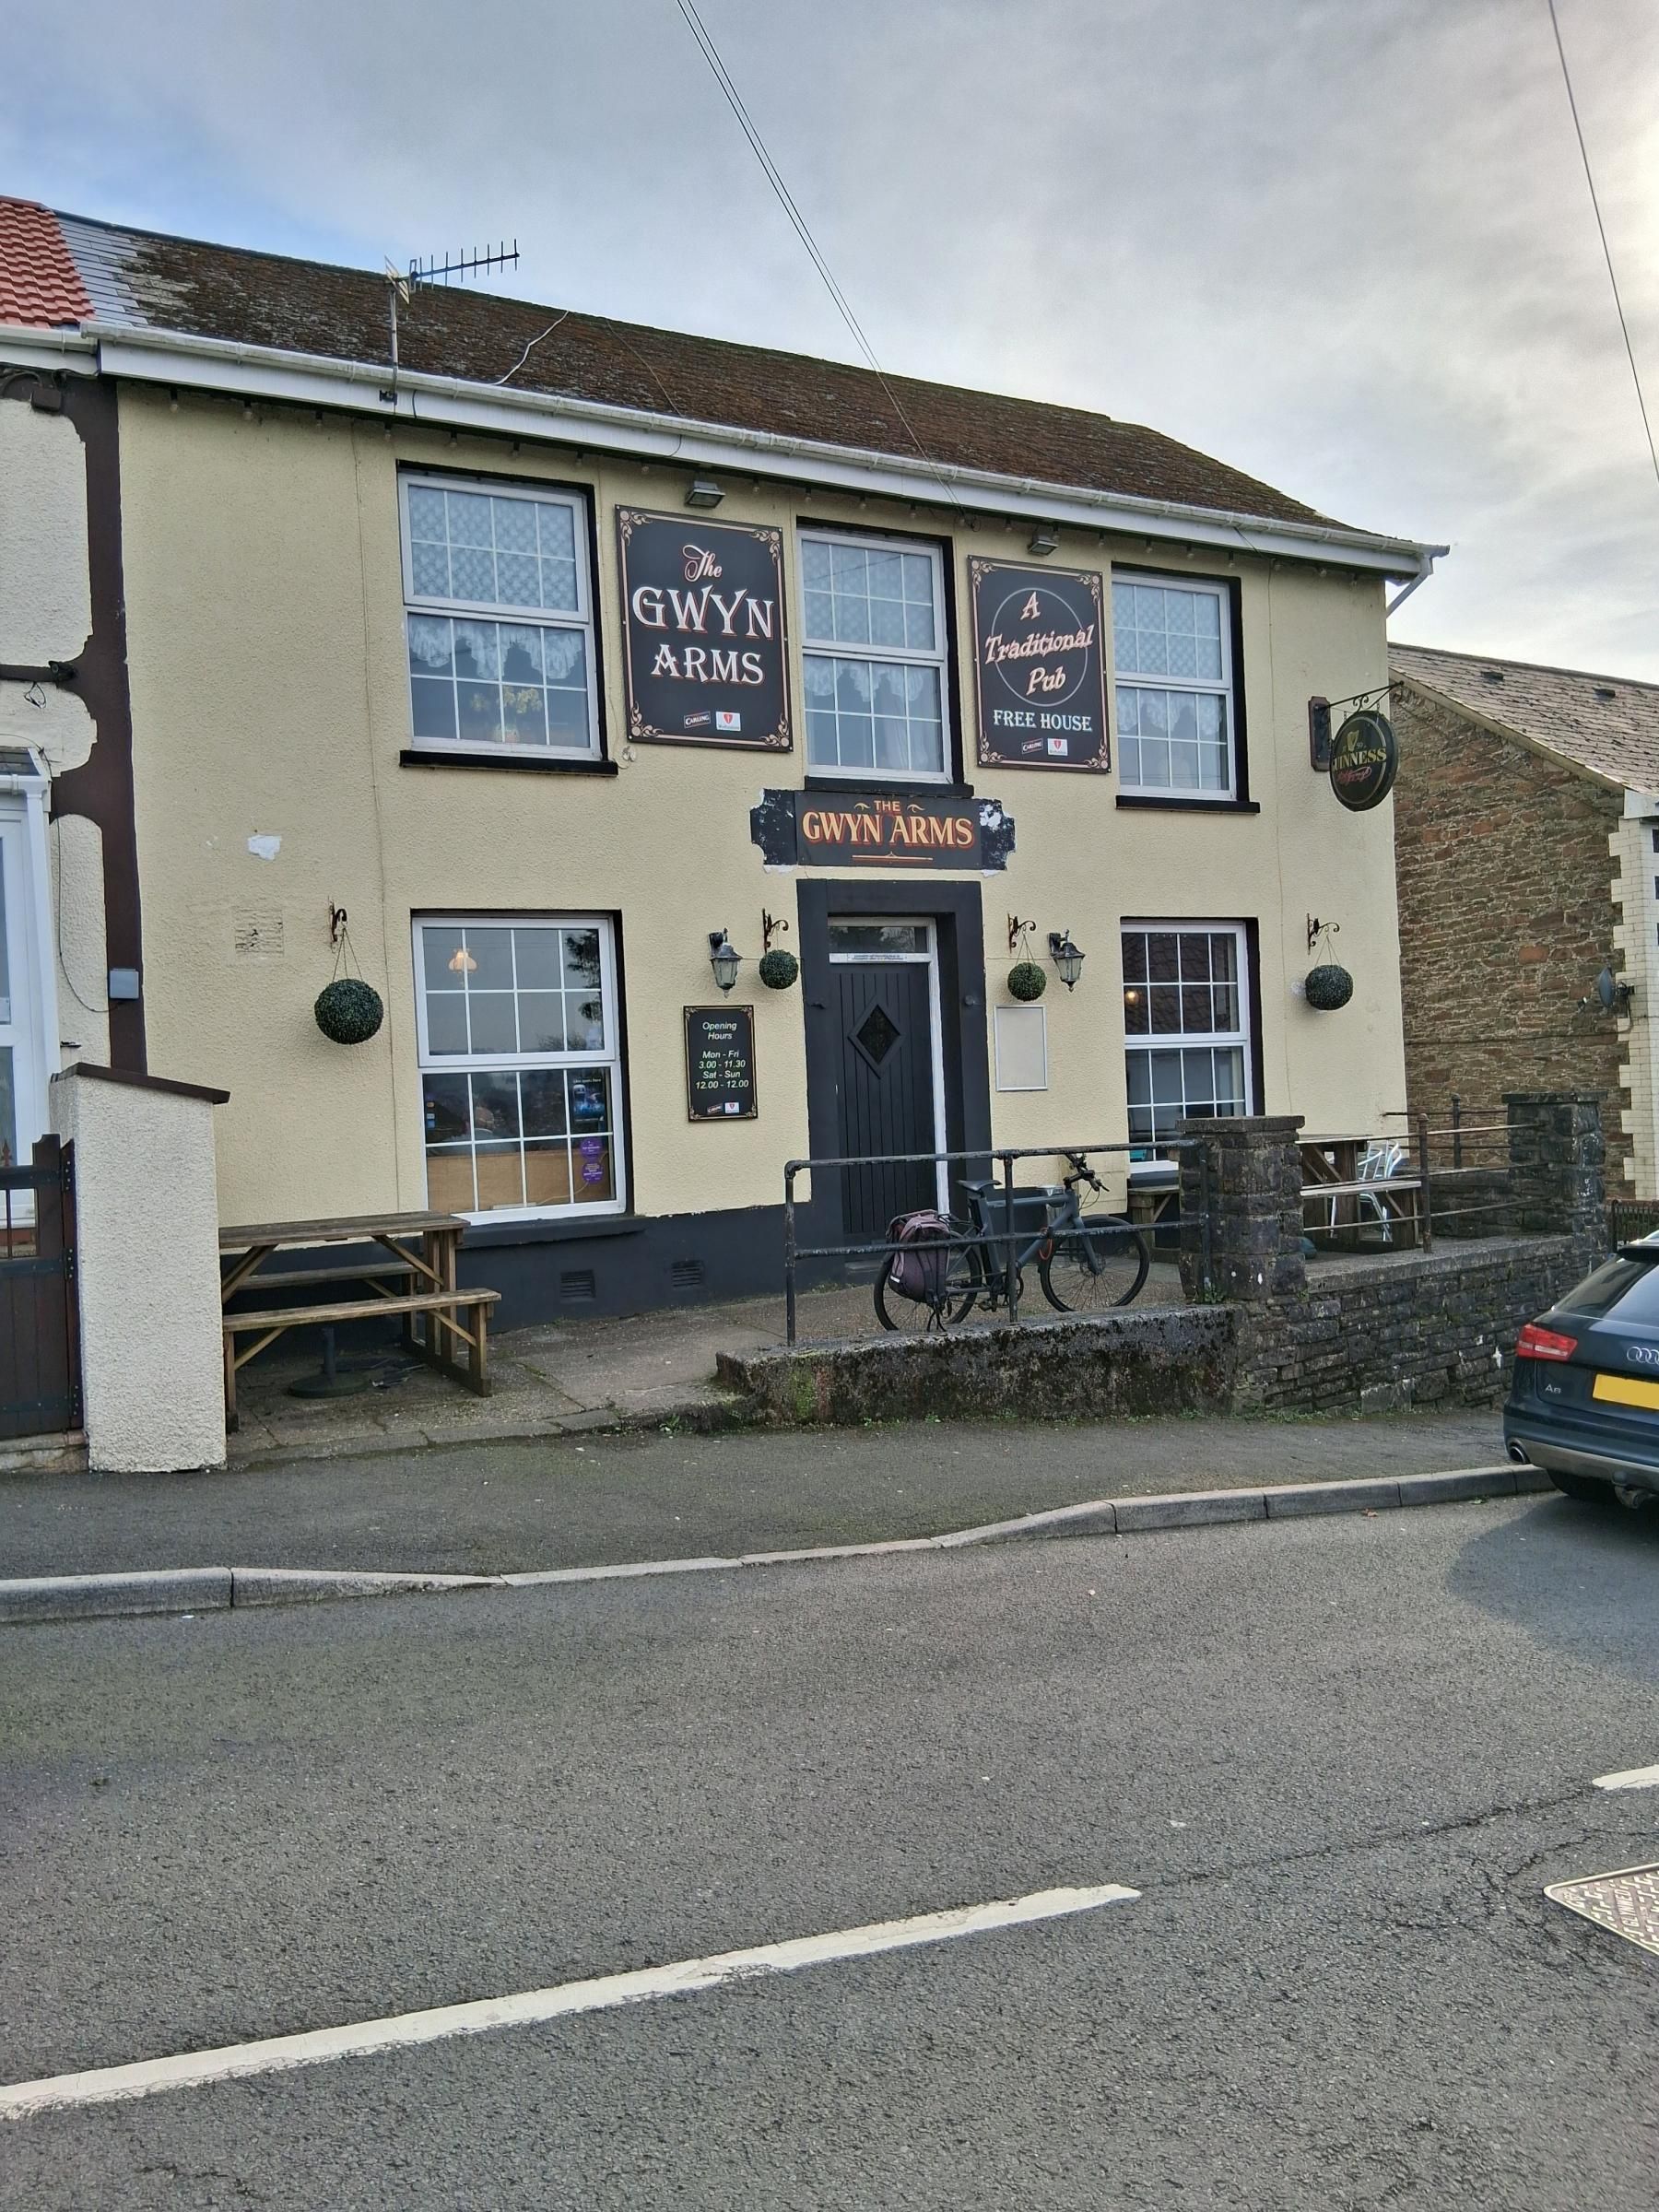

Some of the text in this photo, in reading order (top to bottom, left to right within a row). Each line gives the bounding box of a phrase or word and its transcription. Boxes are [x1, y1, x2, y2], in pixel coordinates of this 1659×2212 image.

[682, 544, 722, 582] The
[632, 584, 774, 641] GWYN
[1020, 591, 1041, 620] A
[984, 624, 1095, 665] Traditional
[651, 643, 765, 686] ARMS
[1026, 665, 1066, 696] Pub
[994, 709, 1093, 732] FREE HOUSE
[874, 799, 901, 812] THE
[802, 811, 975, 849] GWYN ARMS
[702, 1021, 737, 1031] Opening
[707, 1031, 733, 1041] Hours
[699, 1060, 717, 1069] 3.00
[724, 1059, 747, 1068] 11.30
[702, 1050, 721, 1059] Mon
[728, 1050, 739, 1058] Fri
[695, 1080, 719, 1089] 12.00
[726, 1079, 749, 1088] 12.00
[702, 1070, 717, 1079] Sat
[724, 1069, 741, 1078] Sun
[1614, 1888, 1640, 1928] GLYNWED
